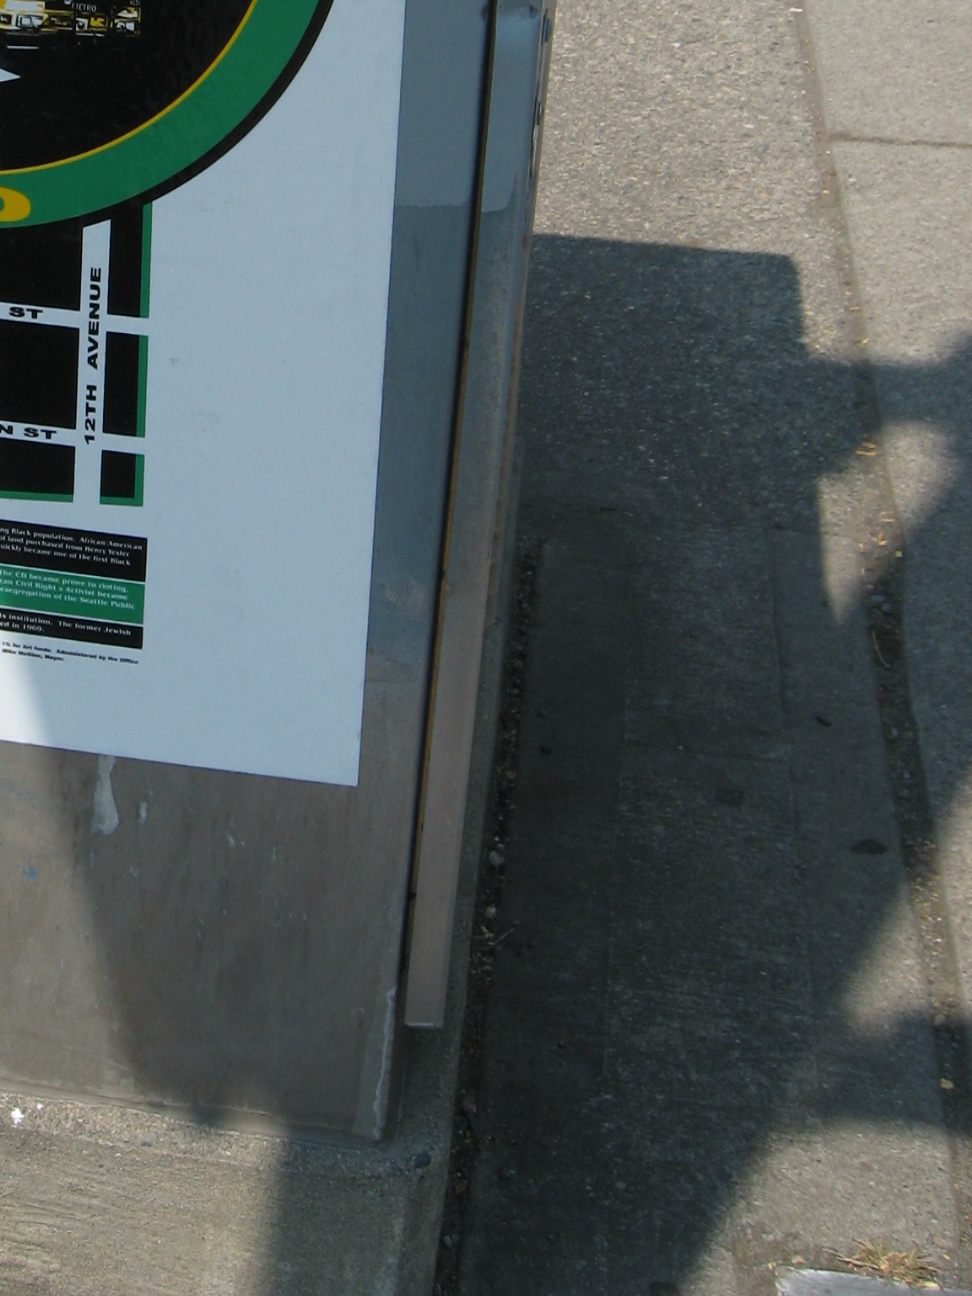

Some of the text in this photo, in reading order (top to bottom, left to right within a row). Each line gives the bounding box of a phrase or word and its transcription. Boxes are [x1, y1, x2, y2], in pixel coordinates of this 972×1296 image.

[8, 306, 44, 321] ST
[84, 267, 103, 446] 12TH AVENUE
[22, 427, 58, 441] ST
